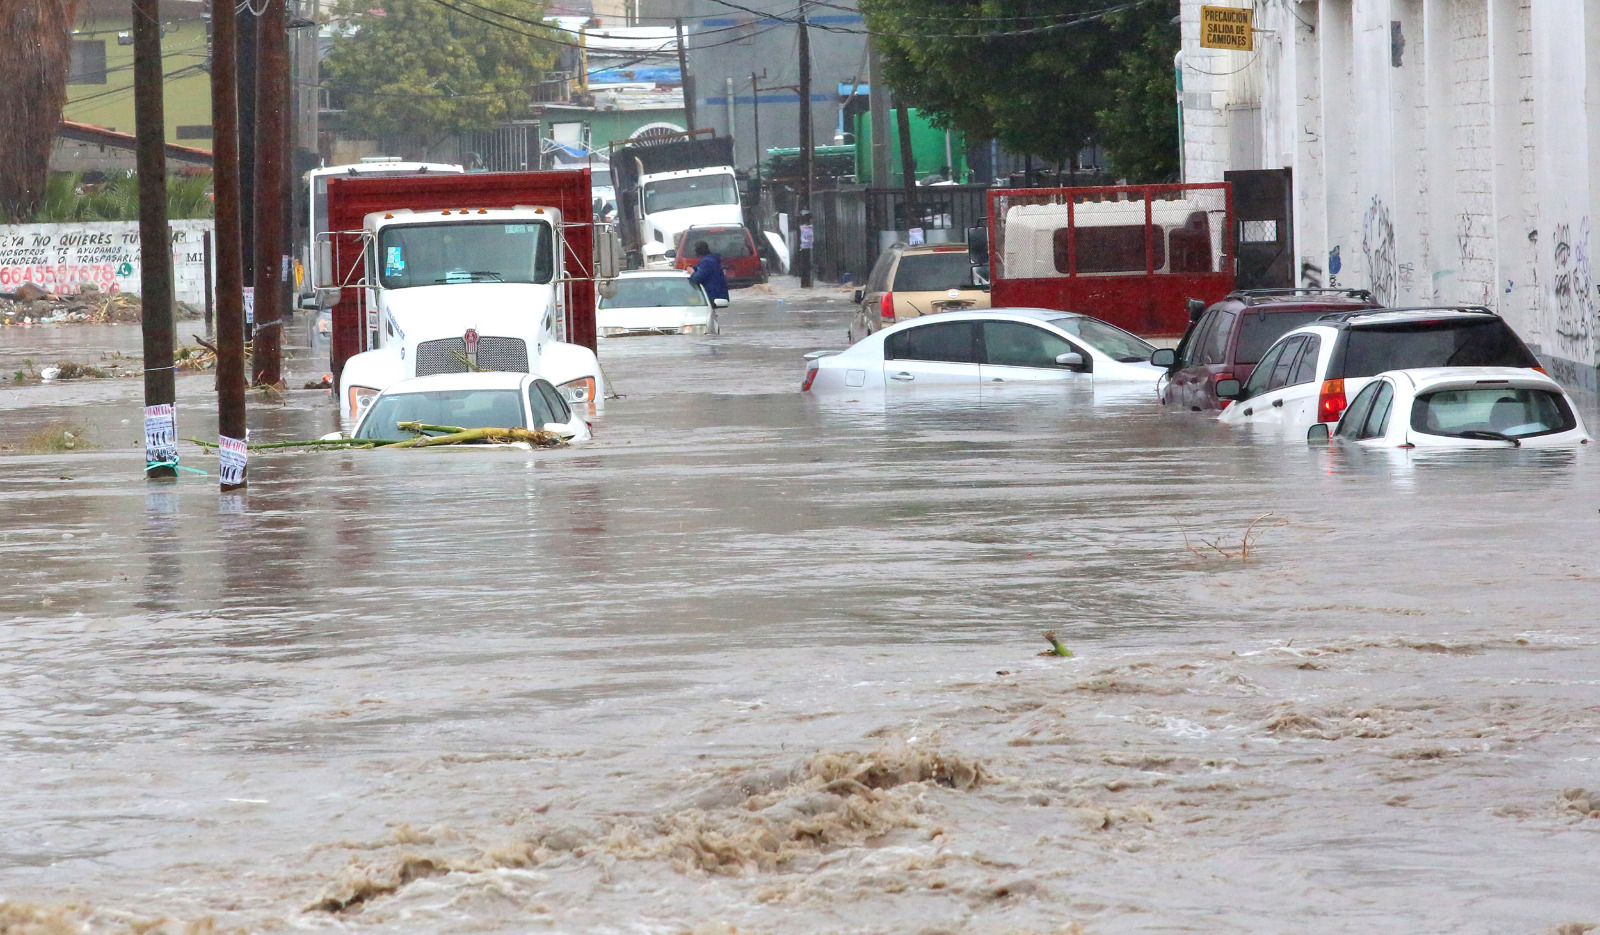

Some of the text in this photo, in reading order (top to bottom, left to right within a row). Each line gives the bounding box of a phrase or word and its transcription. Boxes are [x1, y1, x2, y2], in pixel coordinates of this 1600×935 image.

[1205, 10, 1248, 23] PRECAUCION
[1208, 23, 1245, 35] SALIDA DE
[1207, 33, 1247, 46] CAMIONES
[32, 235, 51, 247] NO
[60, 234, 113, 246] QUIERES
[0, 248, 46, 257] NOSOTROS
[57, 247, 69, 255] TE
[77, 246, 122, 254] AYUDAMOS
[0, 256, 48, 266] VENDERLA
[77, 253, 141, 264] TRASPASARLA
